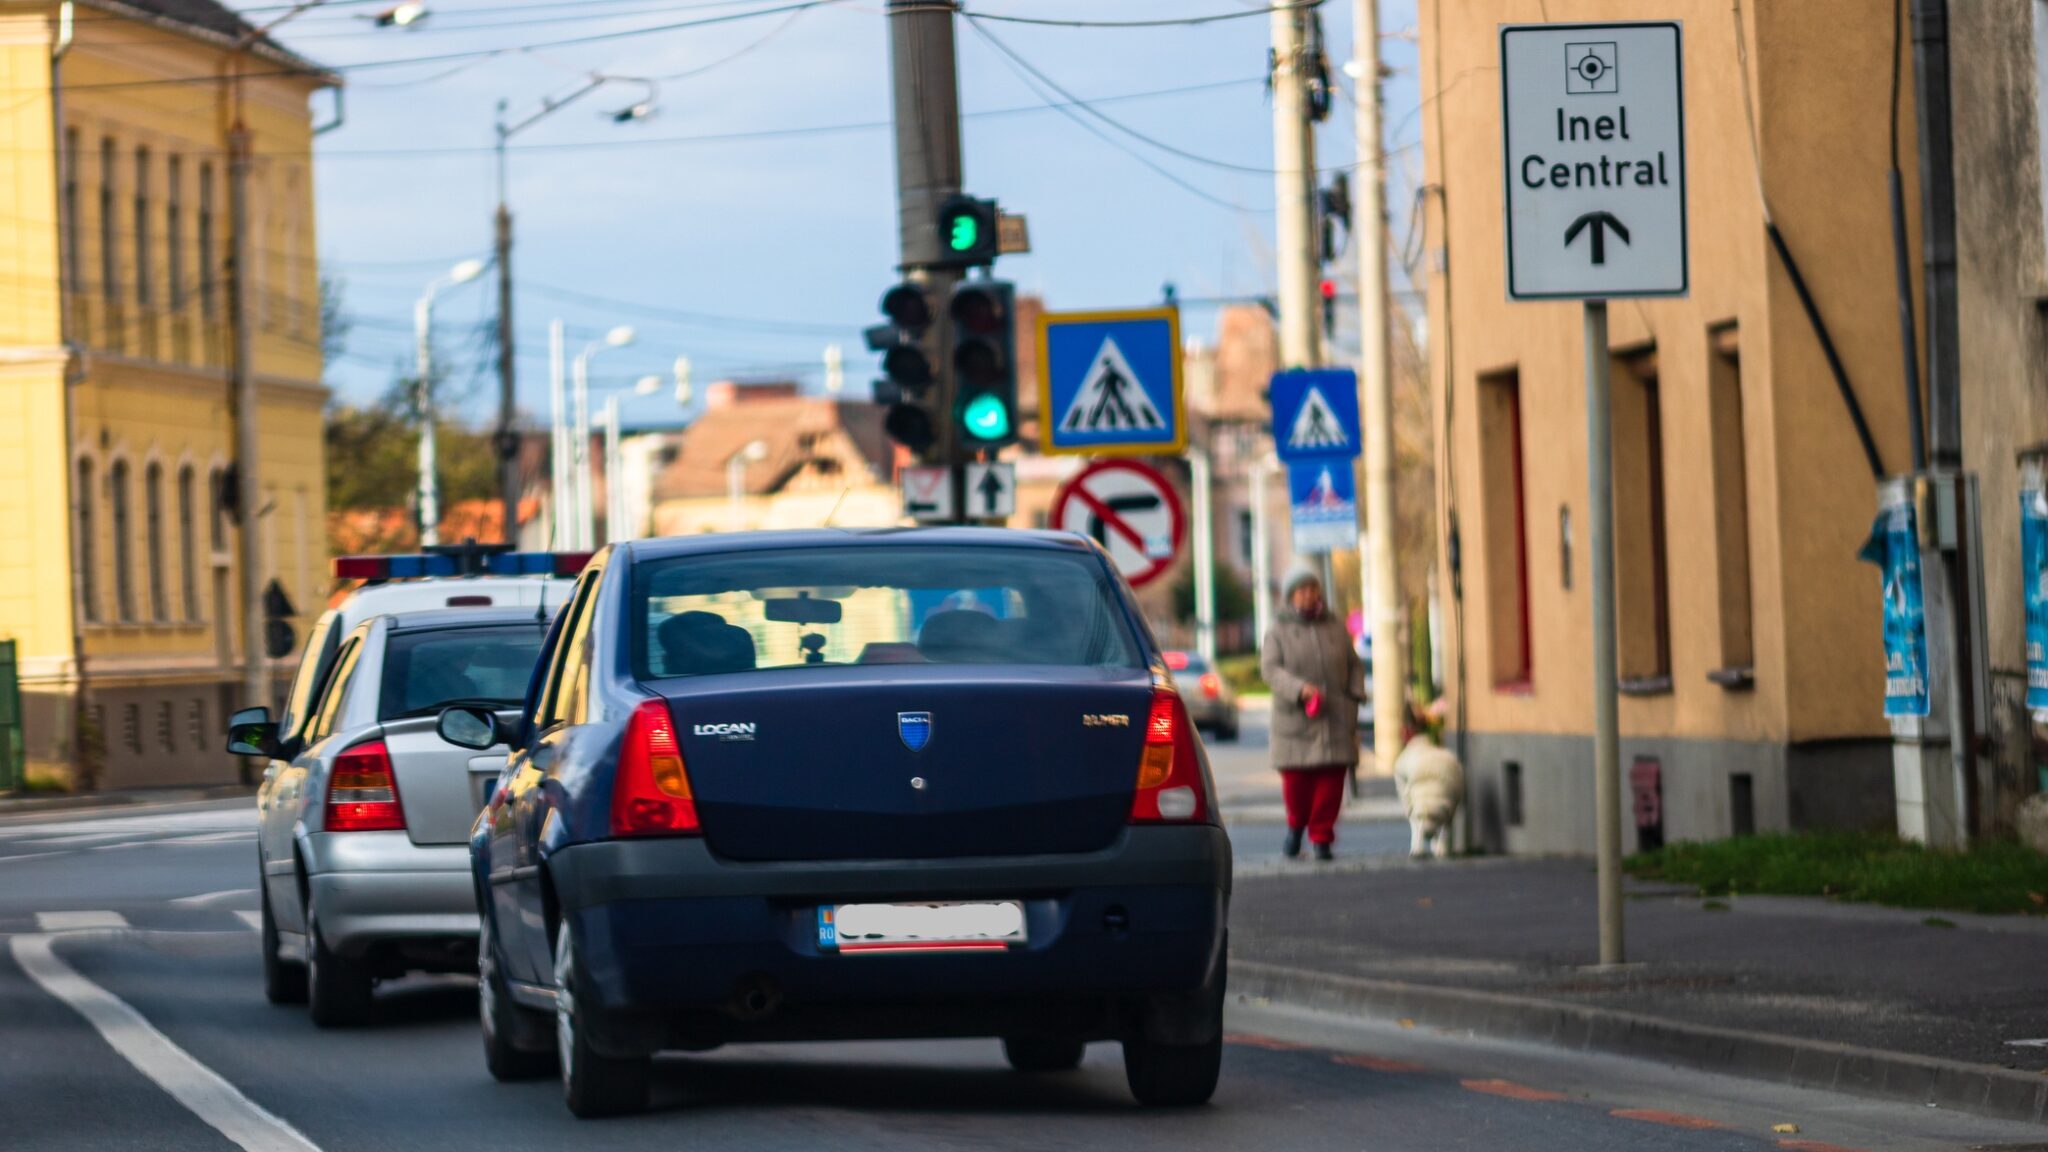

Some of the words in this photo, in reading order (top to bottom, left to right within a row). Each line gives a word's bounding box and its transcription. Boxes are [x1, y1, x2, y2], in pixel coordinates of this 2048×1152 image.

[1556, 105, 1630, 142] Inel
[1521, 151, 1669, 189] Central
[694, 722, 756, 736] LOGAN
[819, 927, 834, 940] RO
